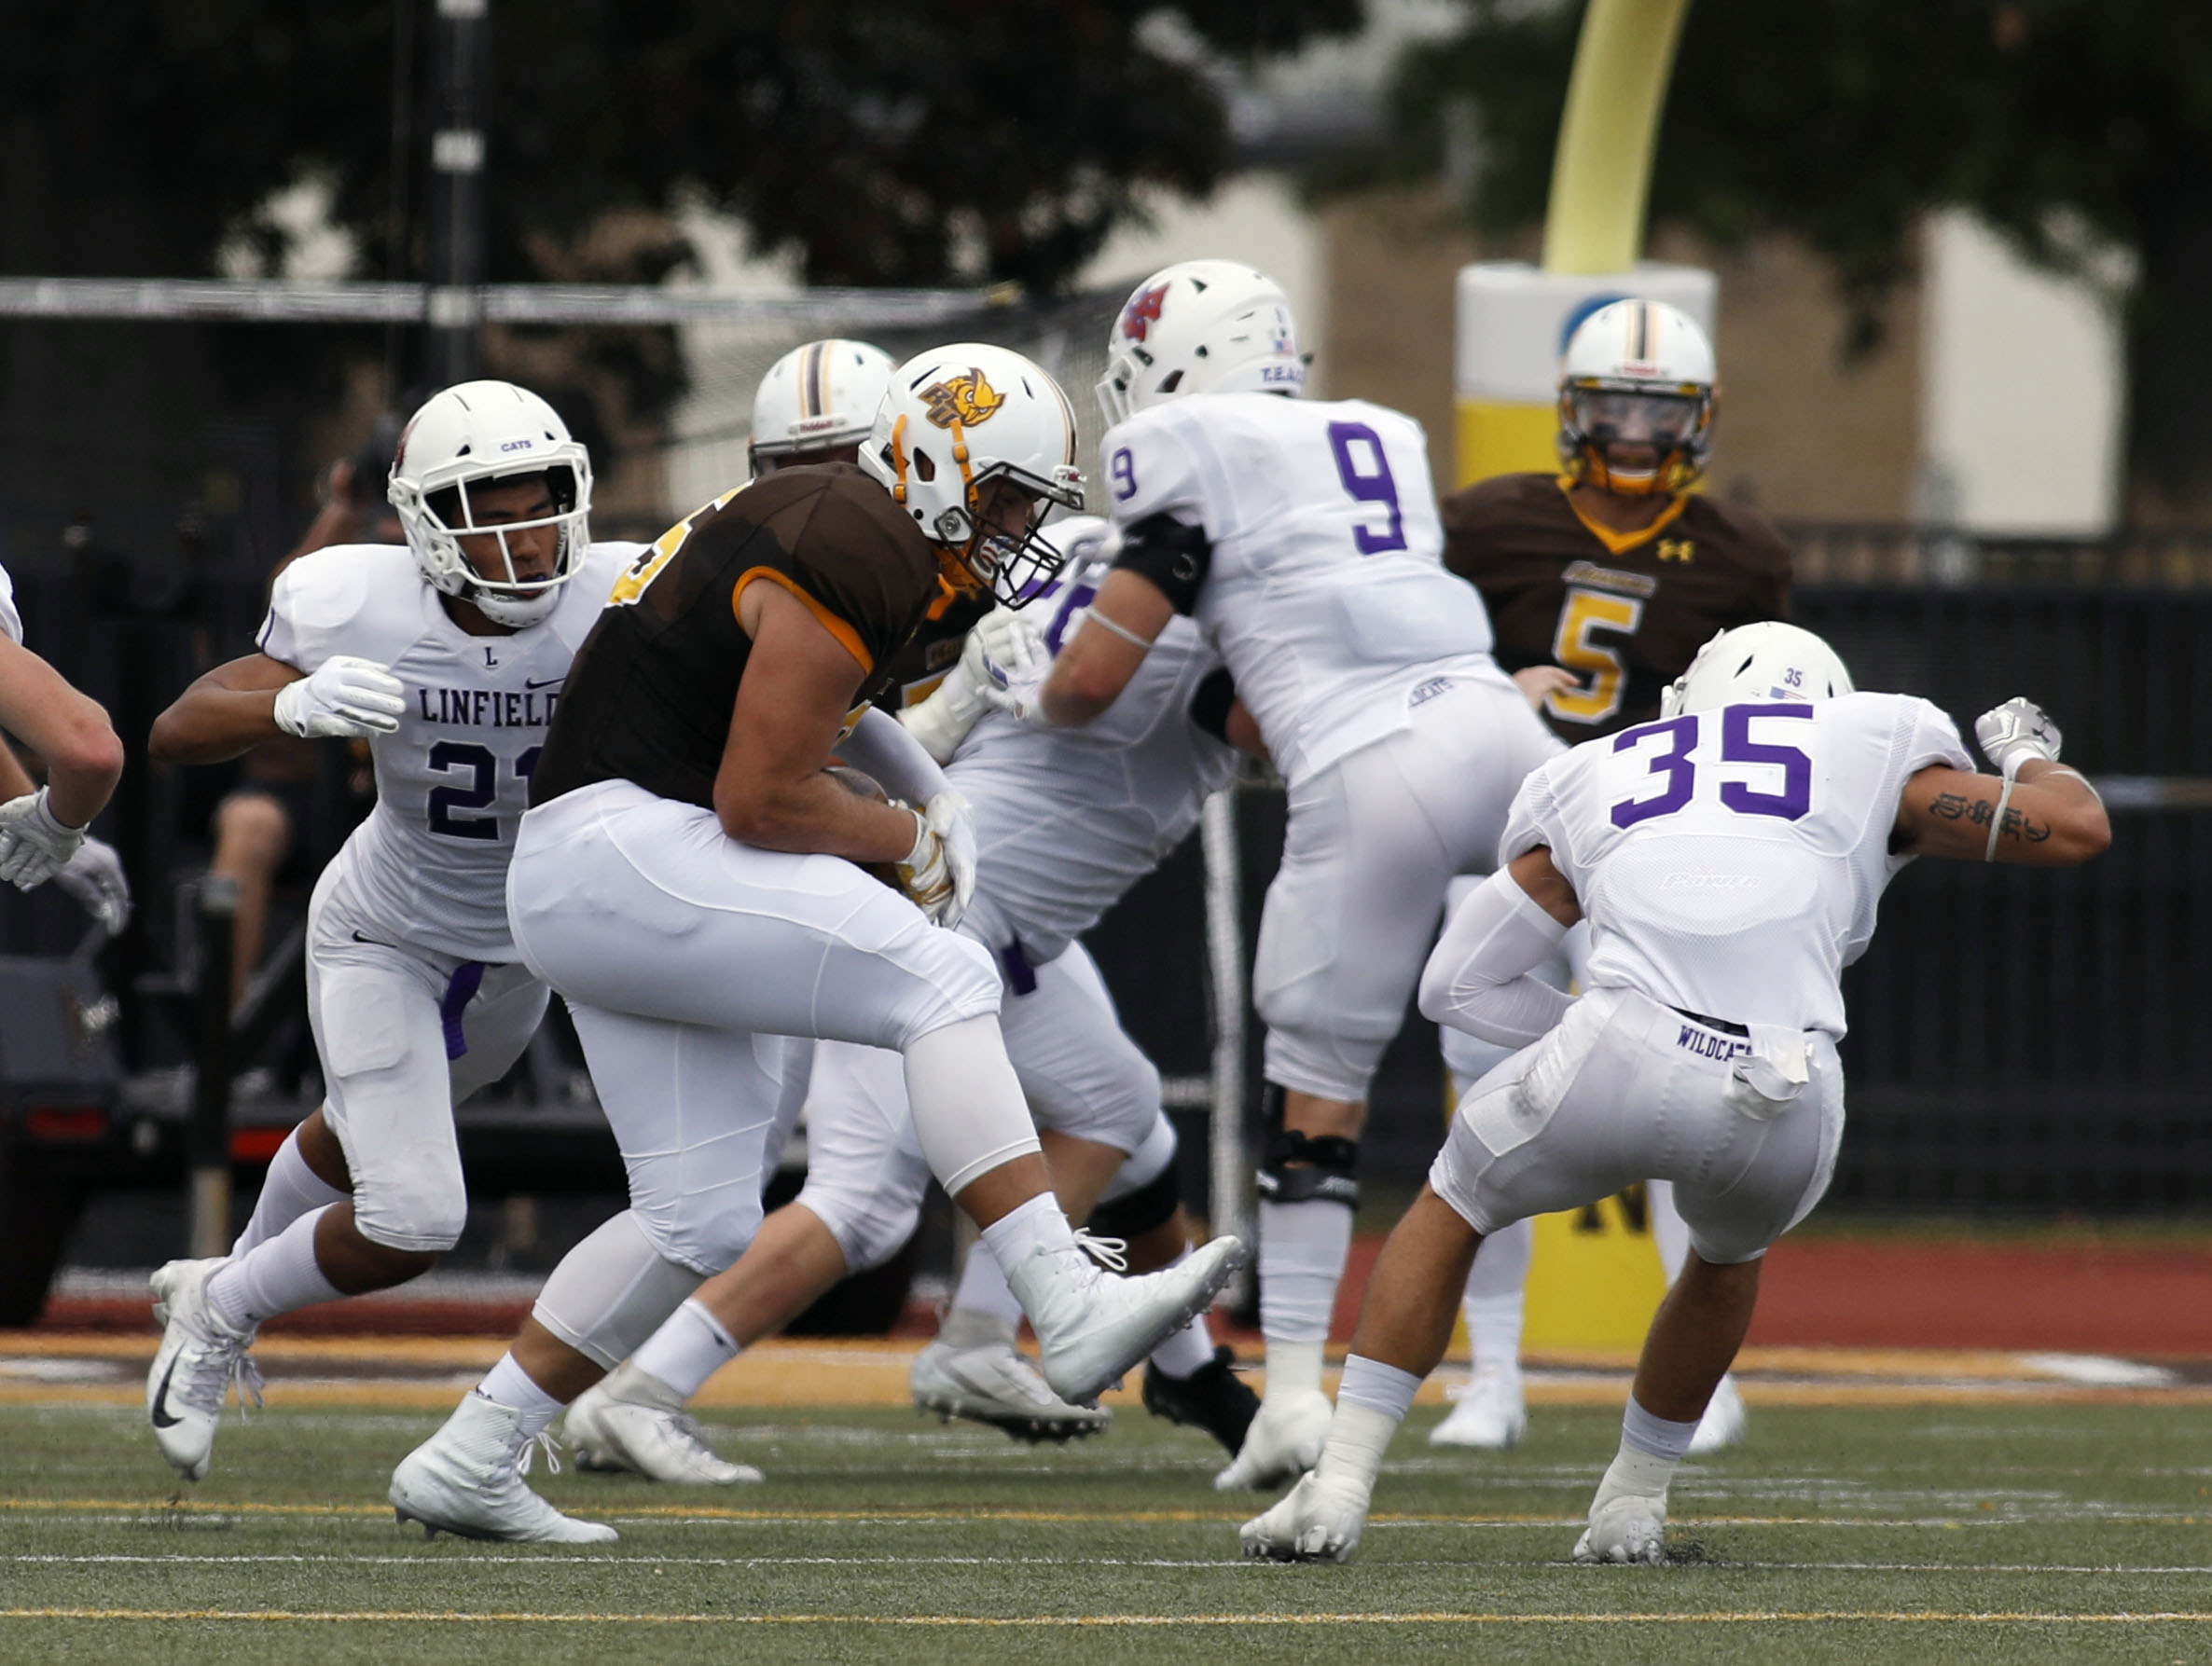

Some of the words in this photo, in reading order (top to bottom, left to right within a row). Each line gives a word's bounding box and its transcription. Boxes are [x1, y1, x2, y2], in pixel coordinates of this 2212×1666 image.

[501, 440, 532, 452] CATS
[1113, 447, 1137, 501] 9
[1328, 420, 1408, 556] 9
[485, 646, 498, 666] L
[1545, 588, 1644, 725] 5
[1783, 668, 1803, 687] 35
[1611, 704, 1814, 830] 35
